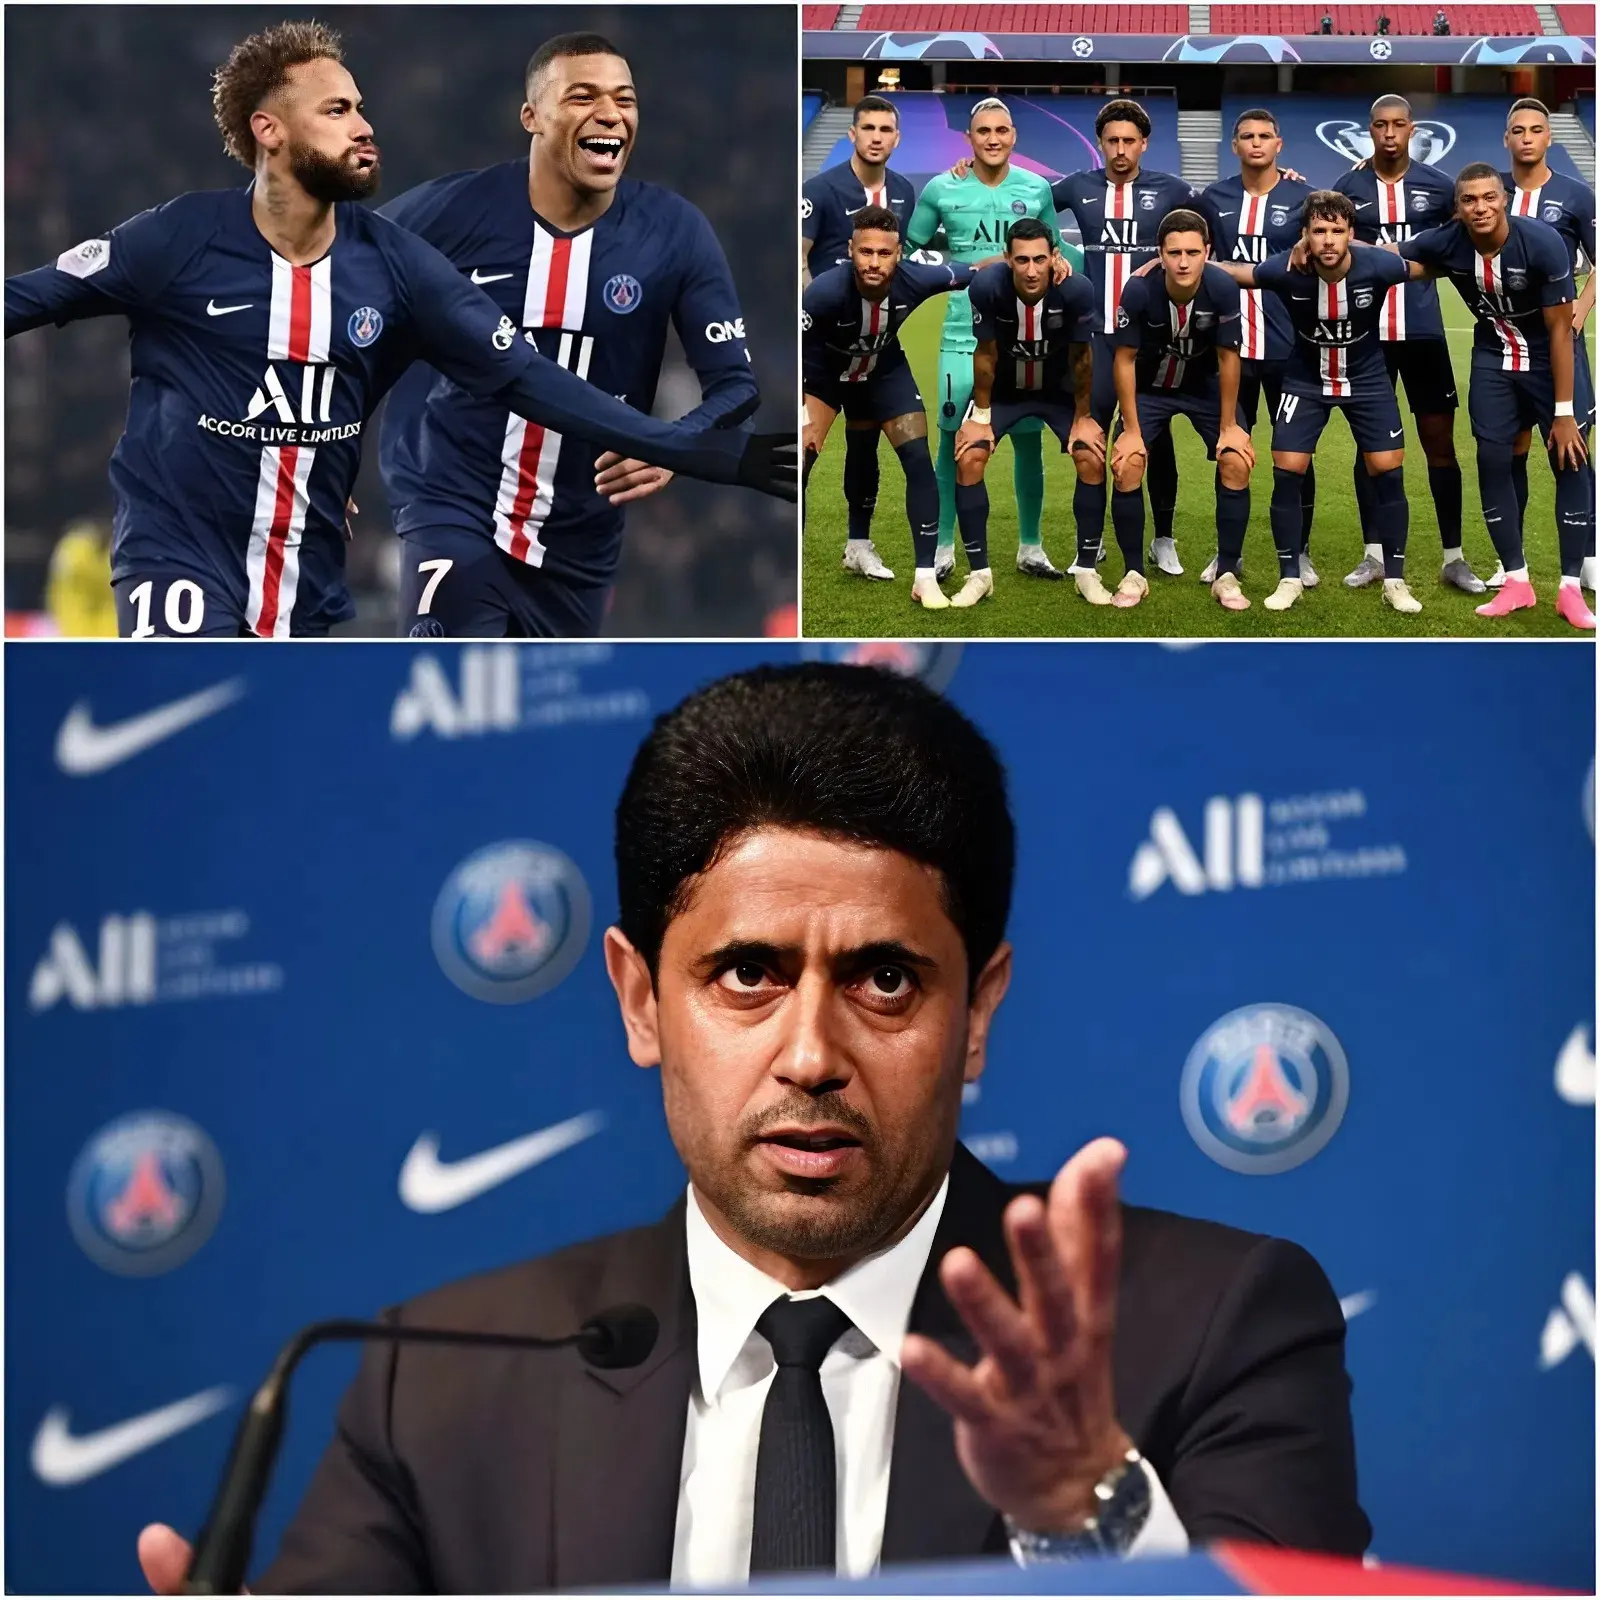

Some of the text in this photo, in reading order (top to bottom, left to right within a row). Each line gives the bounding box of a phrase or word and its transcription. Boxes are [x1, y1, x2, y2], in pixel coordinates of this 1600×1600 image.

[197, 414, 256, 440] ACCOR
[260, 427, 298, 442] LIVE
[1275, 392, 1300, 424] 14
[128, 579, 205, 638] 10
[416, 558, 454, 616] 7
